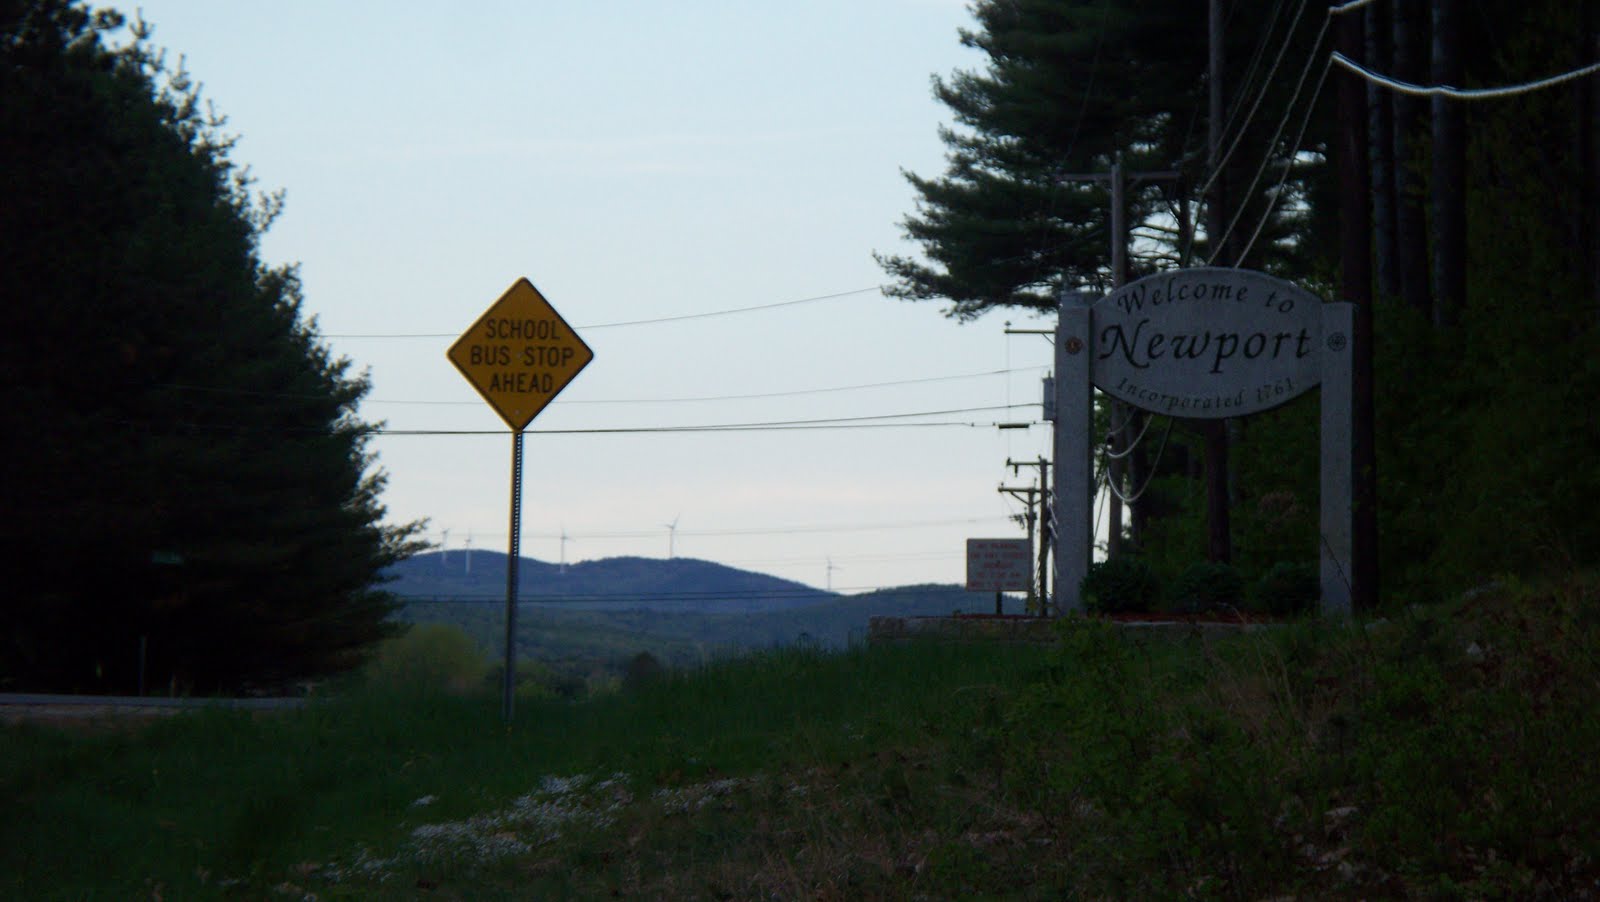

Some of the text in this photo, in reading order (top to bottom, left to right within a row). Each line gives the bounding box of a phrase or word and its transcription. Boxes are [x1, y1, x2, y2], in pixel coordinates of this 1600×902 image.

[1117, 277, 1295, 315] Welcome to
[486, 318, 561, 341] SCHOOL
[470, 345, 575, 367] BUS STOP
[1099, 319, 1312, 374] Newport
[489, 372, 553, 394] AHEAD
[1116, 377, 1297, 411] Incorporated 1761
